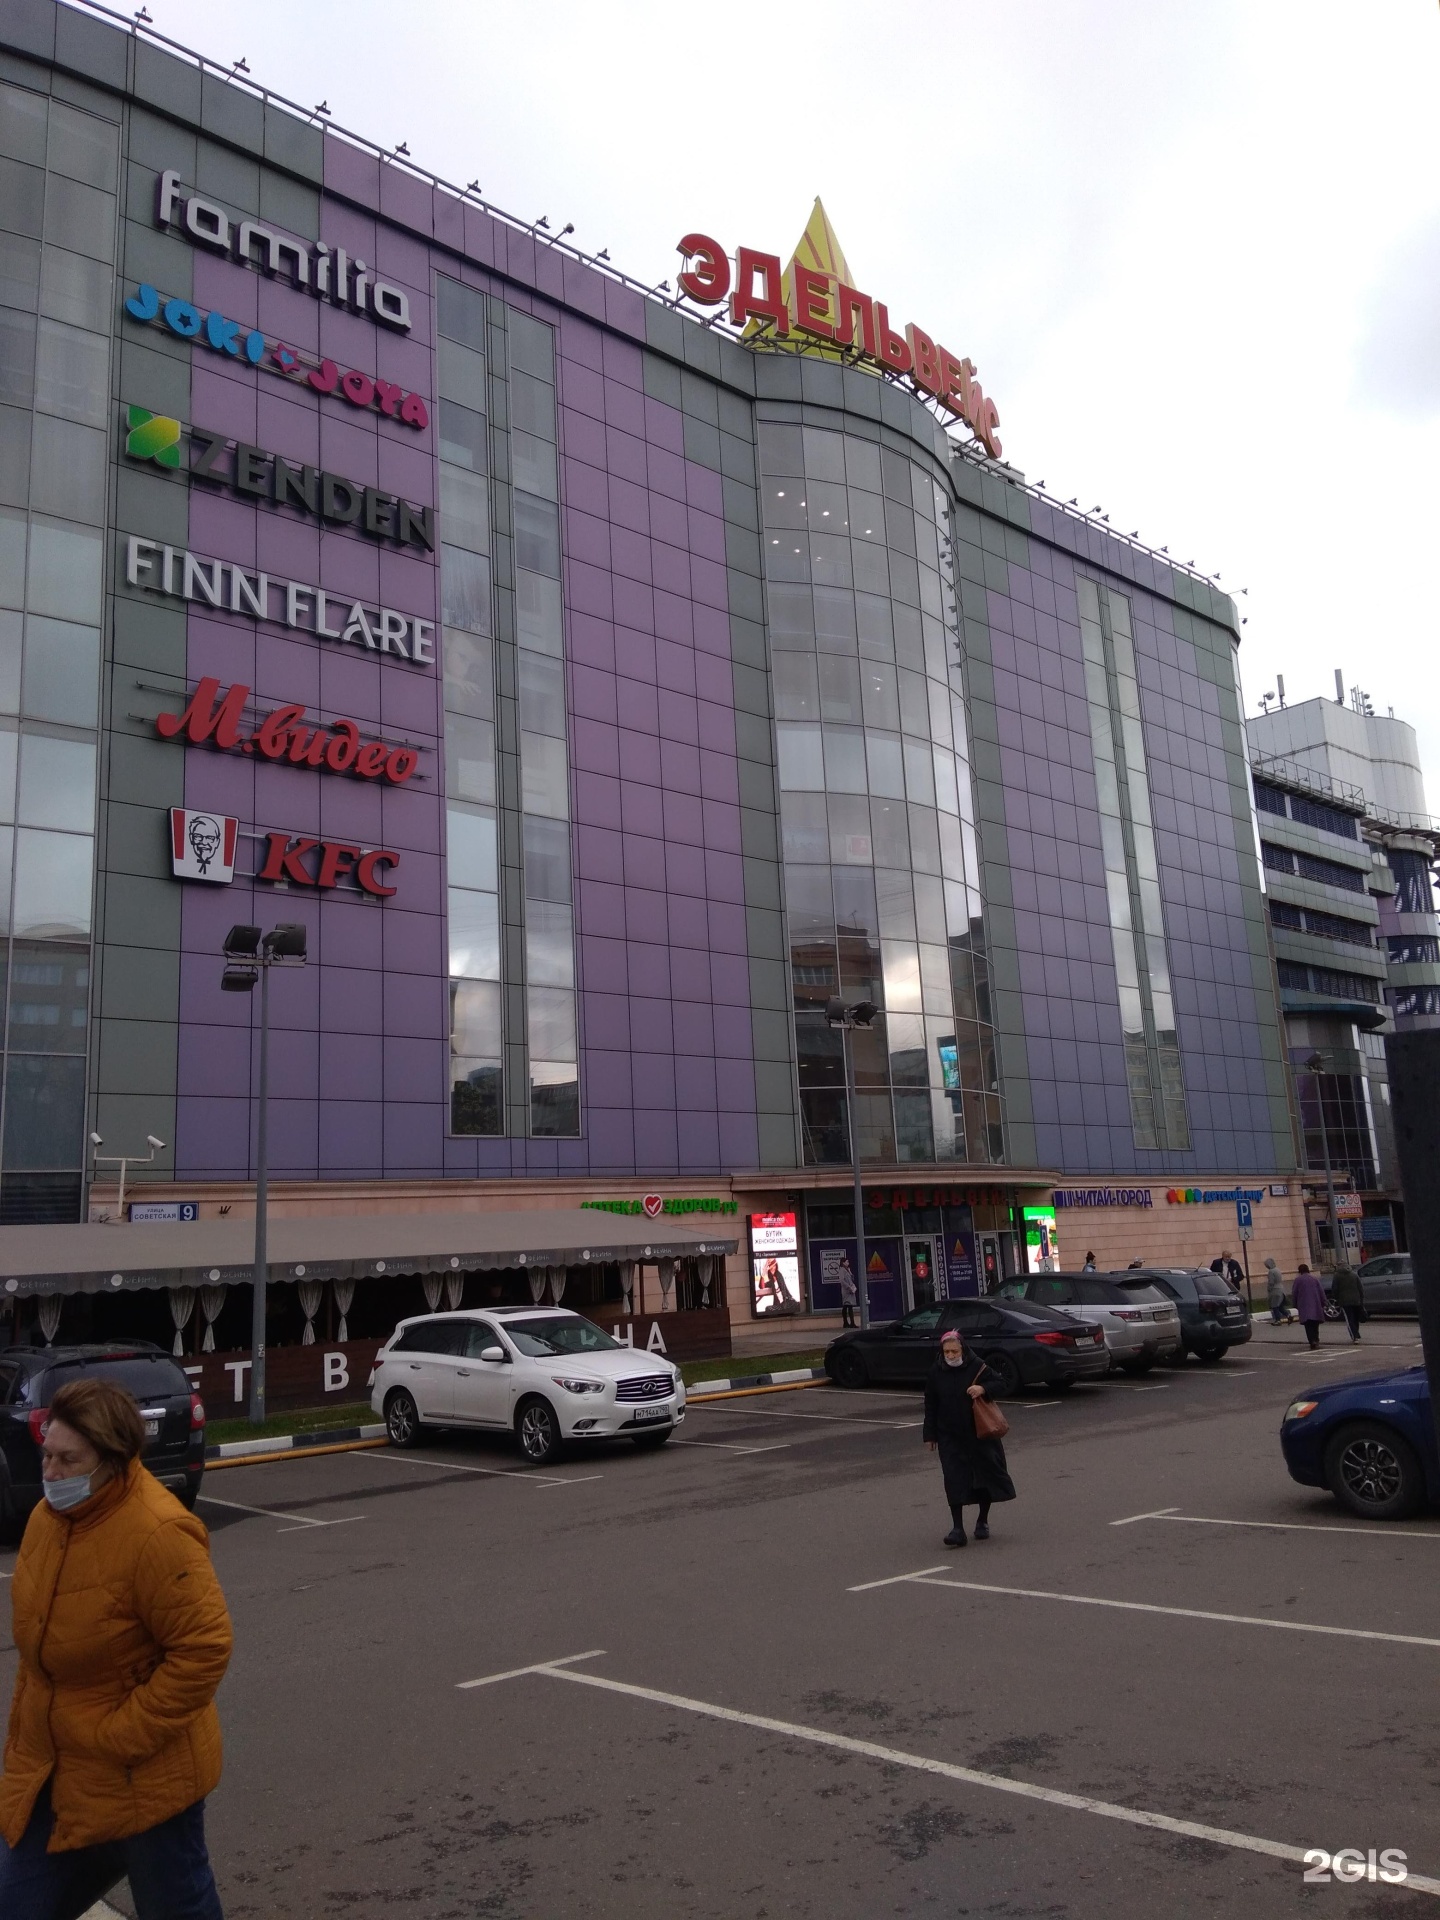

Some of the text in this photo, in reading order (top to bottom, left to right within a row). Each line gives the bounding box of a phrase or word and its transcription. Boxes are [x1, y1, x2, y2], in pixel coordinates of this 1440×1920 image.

[157, 169, 412, 334] familia
[125, 283, 430, 430] JOKI JOYA
[676, 232, 1003, 460] ЭДЕЛЬВЕЙС
[187, 427, 435, 553] ZENDEN
[127, 535, 435, 665] FINN FLARE
[155, 676, 419, 784] М.видео
[256, 831, 400, 898] KFC
[182, 1205, 194, 1221] 9
[765, 1230, 782, 1238] БУТИК
[1074, 1185, 1153, 1208] ЧИТАЙ-ГОРОД
